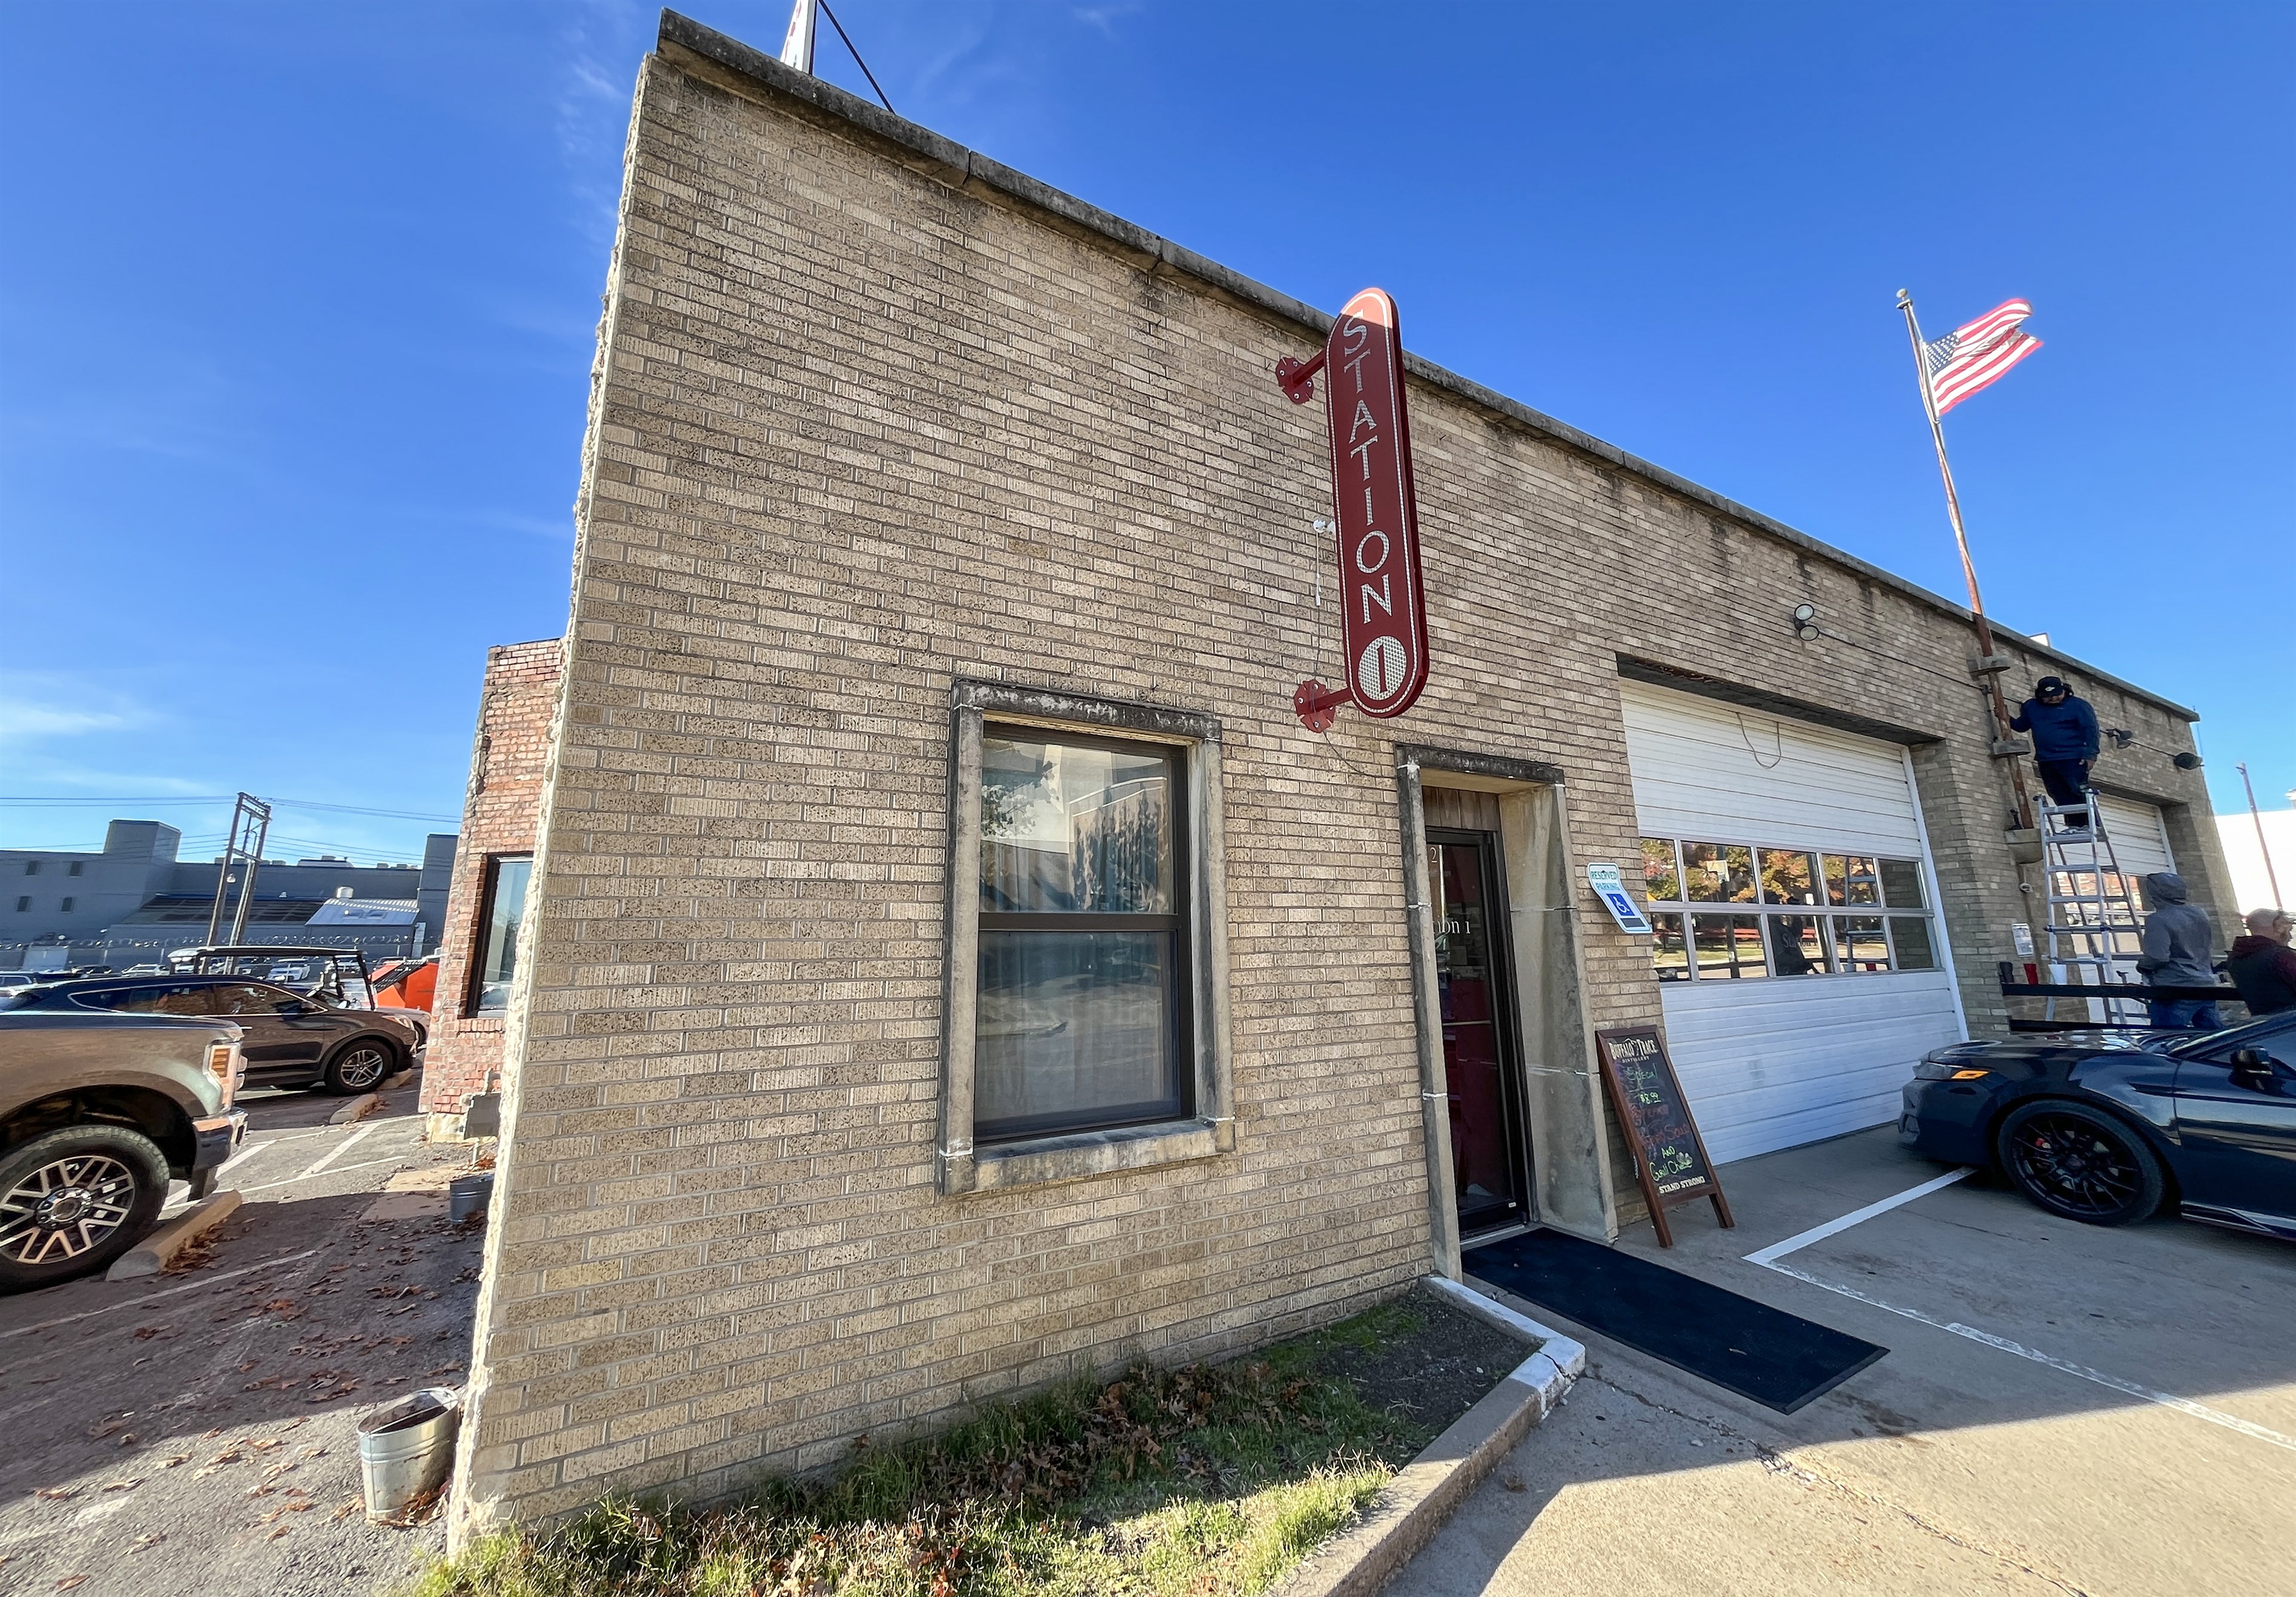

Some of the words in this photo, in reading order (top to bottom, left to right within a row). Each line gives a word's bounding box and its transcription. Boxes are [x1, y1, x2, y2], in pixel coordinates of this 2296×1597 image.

[1342, 309, 1393, 624] STATION
[1376, 641, 1388, 694] 1
[1590, 871, 1616, 880] RESERVED
[1608, 1042, 1635, 1061] BUFFALO
[1636, 1039, 1659, 1057] TRACE
[1659, 1182, 1681, 1194] STAND
[1680, 1175, 1706, 1189] STRONG
